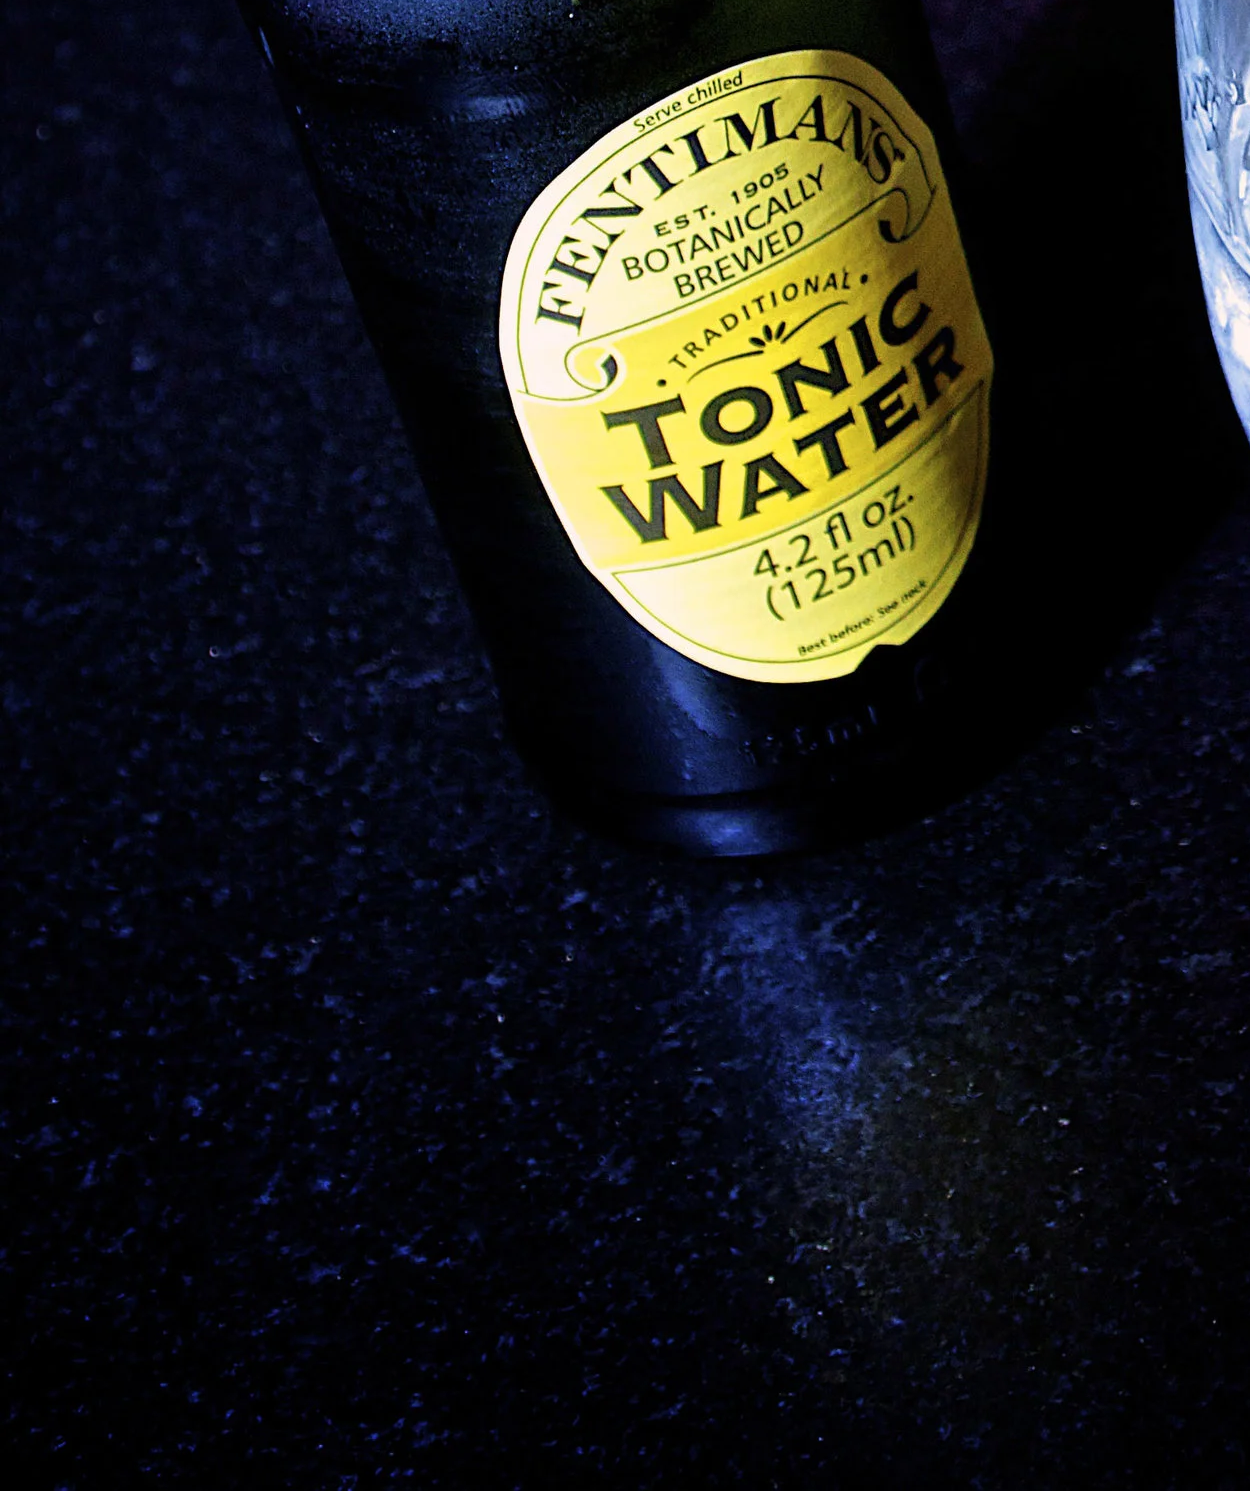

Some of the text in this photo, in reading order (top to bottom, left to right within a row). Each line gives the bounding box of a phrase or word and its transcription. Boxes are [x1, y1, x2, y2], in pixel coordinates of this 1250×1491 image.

[633, 70, 743, 133] Serve chilled
[536, 94, 905, 335] FENTIMANS
[621, 163, 825, 282] BOTANICALLY
[653, 162, 789, 238] EST. 1905
[673, 220, 805, 299] BREWED
[603, 269, 932, 472] TONIC
[667, 268, 853, 371] TRADITIONAL
[599, 325, 965, 545] WATER
[753, 484, 915, 578] 4.2 fl oz.
[765, 515, 916, 622] (125ml)
[798, 638, 827, 656] Best
